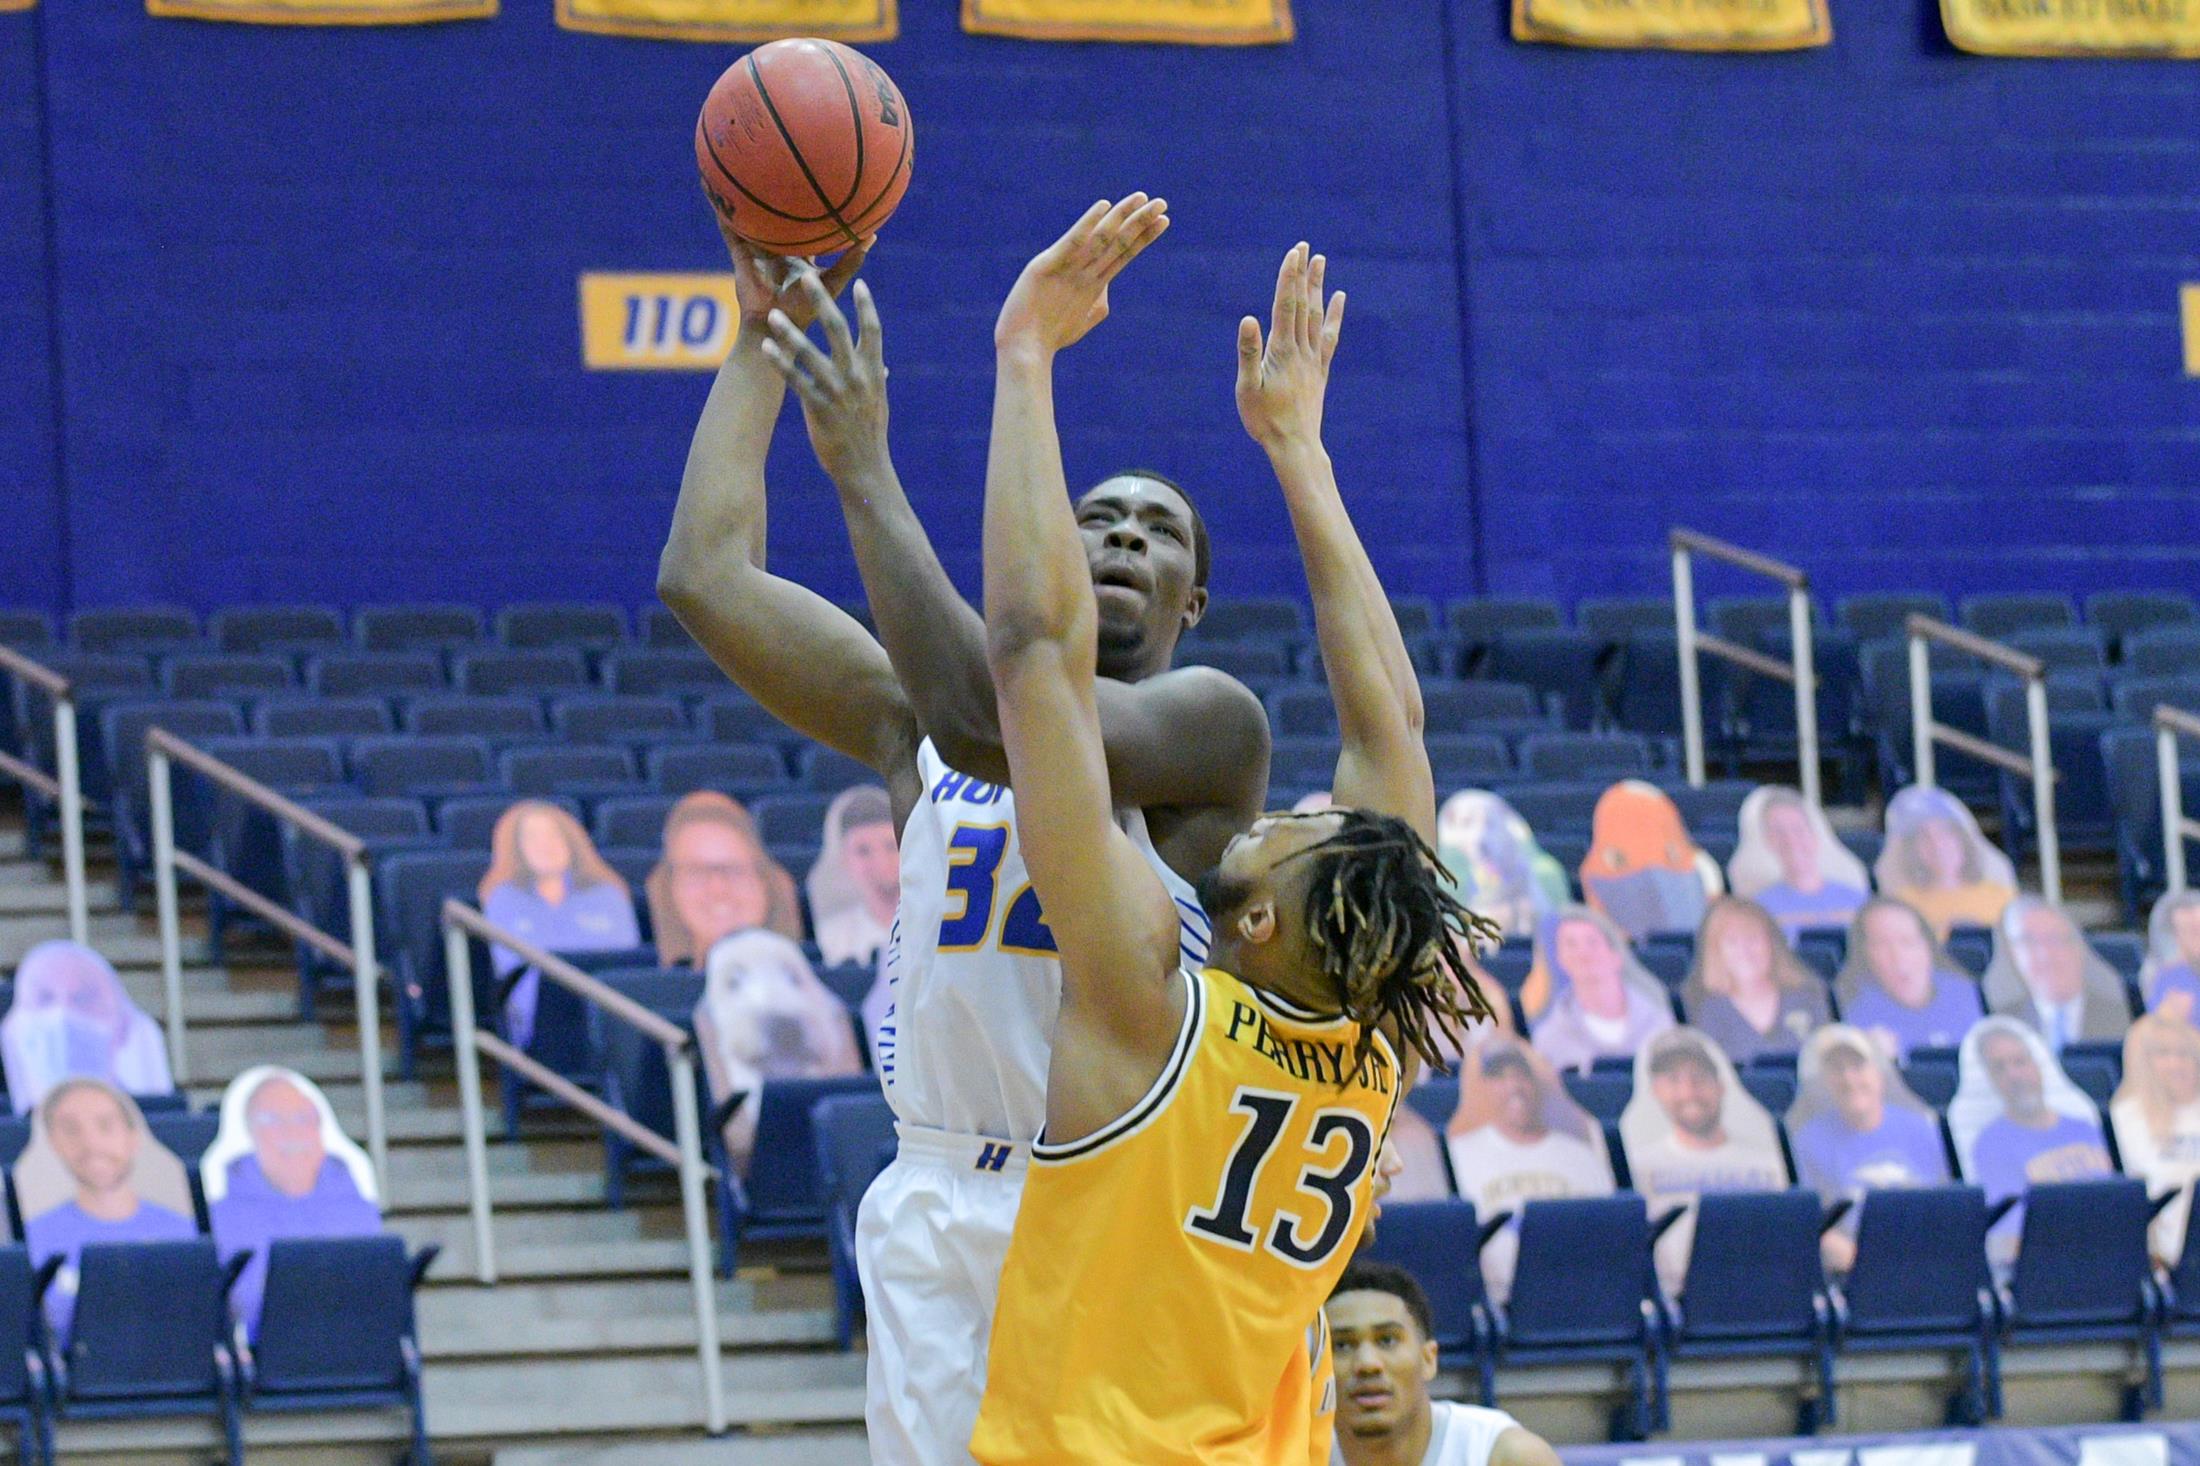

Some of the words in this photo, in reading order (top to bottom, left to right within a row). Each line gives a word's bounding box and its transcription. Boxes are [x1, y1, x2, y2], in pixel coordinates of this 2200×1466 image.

[624, 294, 719, 347] 110
[974, 1141, 1014, 1174] H
[1183, 1084, 1375, 1271] 13
